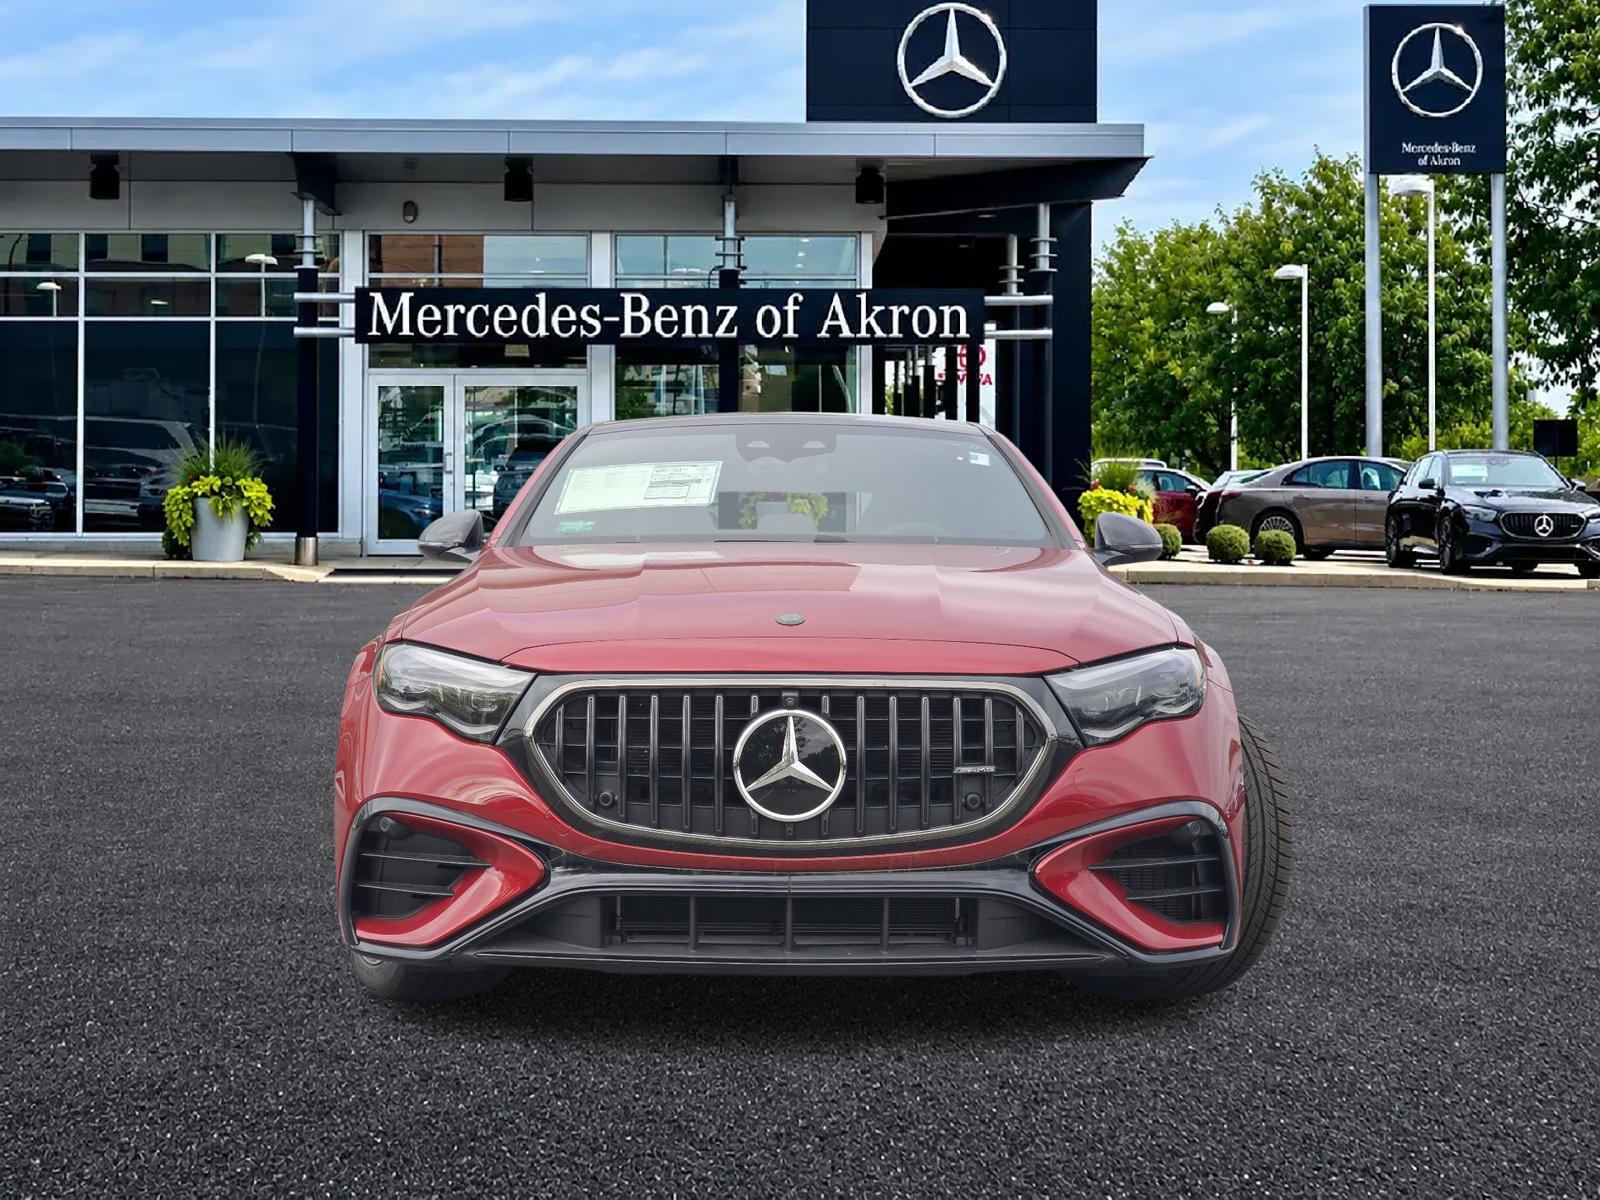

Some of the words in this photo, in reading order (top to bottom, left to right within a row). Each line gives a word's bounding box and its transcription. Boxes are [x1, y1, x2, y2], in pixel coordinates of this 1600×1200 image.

[1401, 141, 1476, 153] Mercedes-Benz
[1418, 154, 1428, 165] of
[1430, 154, 1460, 165] Akron
[367, 292, 738, 338] Mercedes-Benz
[755, 291, 803, 338] of
[816, 291, 969, 338] Akron
